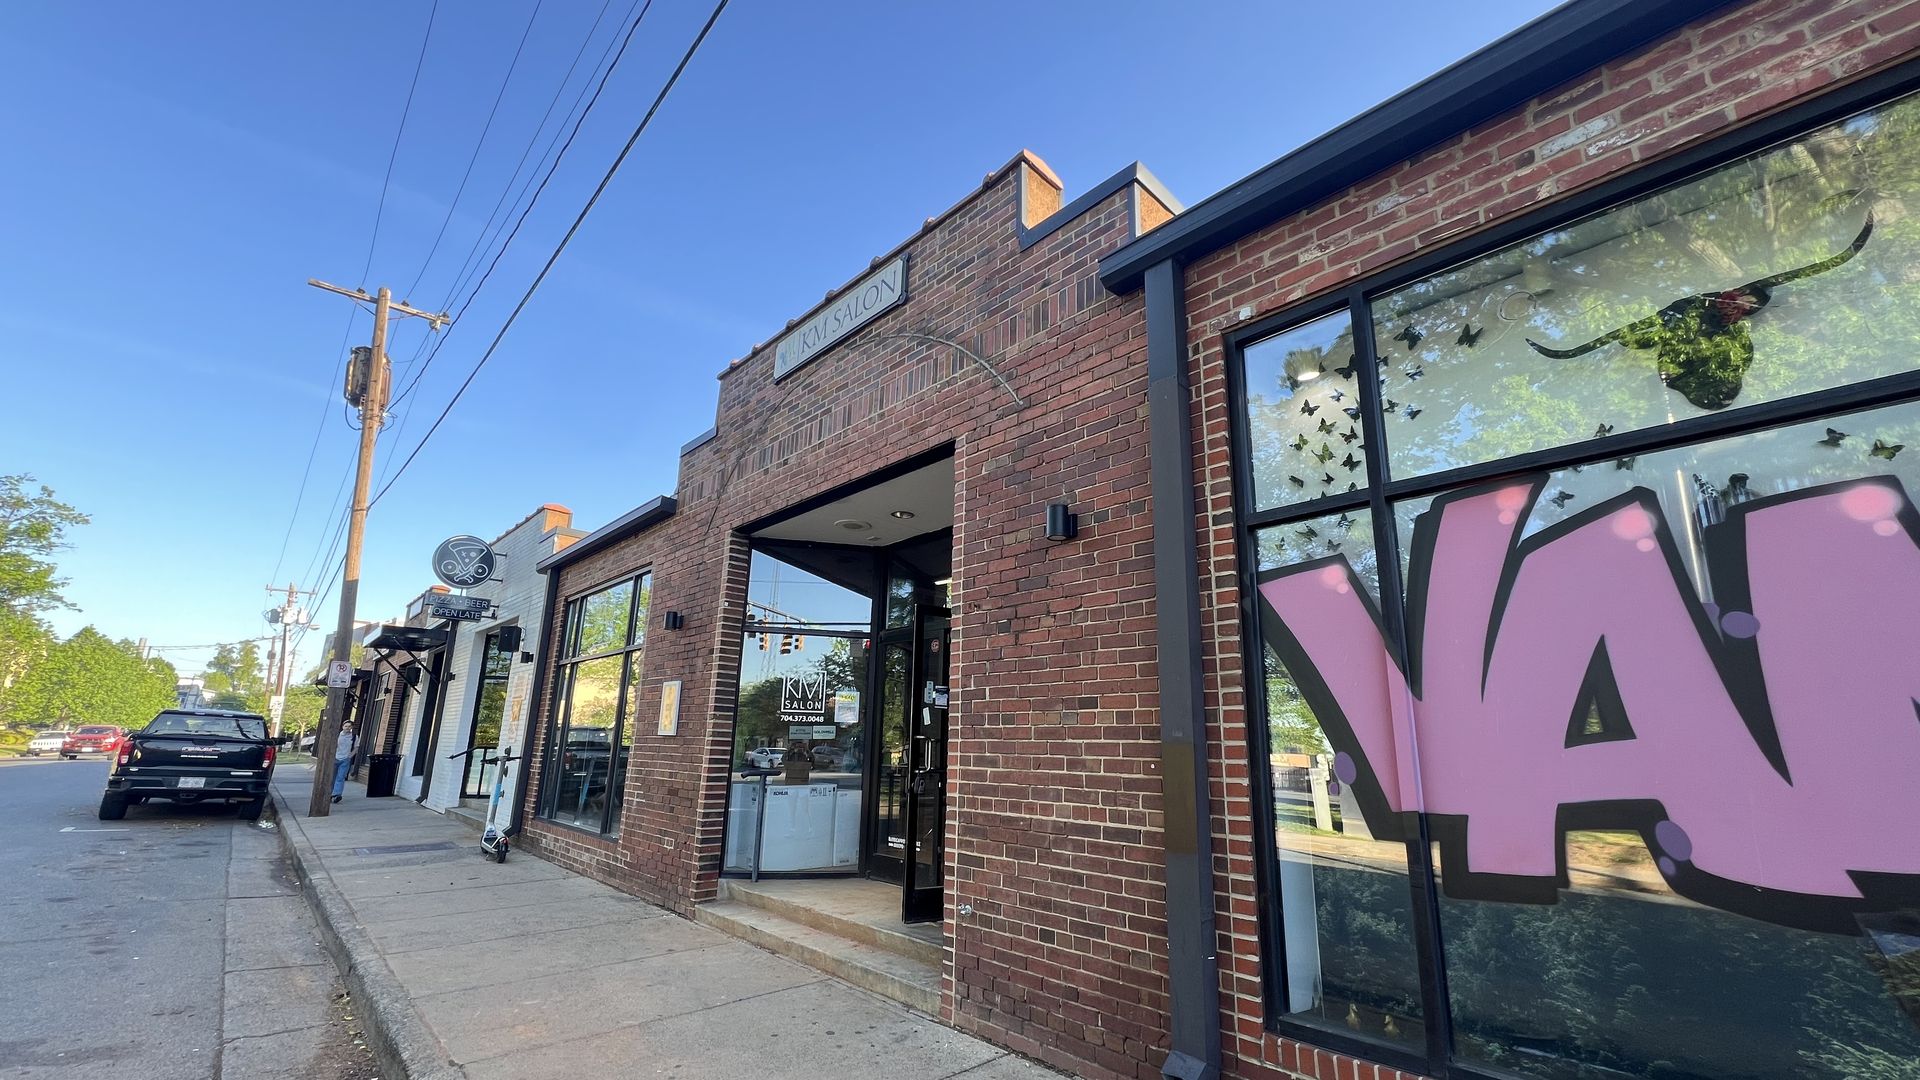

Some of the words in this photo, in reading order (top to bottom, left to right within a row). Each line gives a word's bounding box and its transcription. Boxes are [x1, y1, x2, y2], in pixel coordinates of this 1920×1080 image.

[801, 318, 829, 353] KM
[832, 270, 897, 333] SALON
[429, 594, 457, 605] PIZZA
[465, 599, 488, 608] BEER
[433, 607, 457, 617] OPEN
[459, 611, 481, 619] LATE
[786, 673, 823, 700] KM
[785, 700, 821, 710] SALON
[780, 714, 825, 722] 704.373.0048
